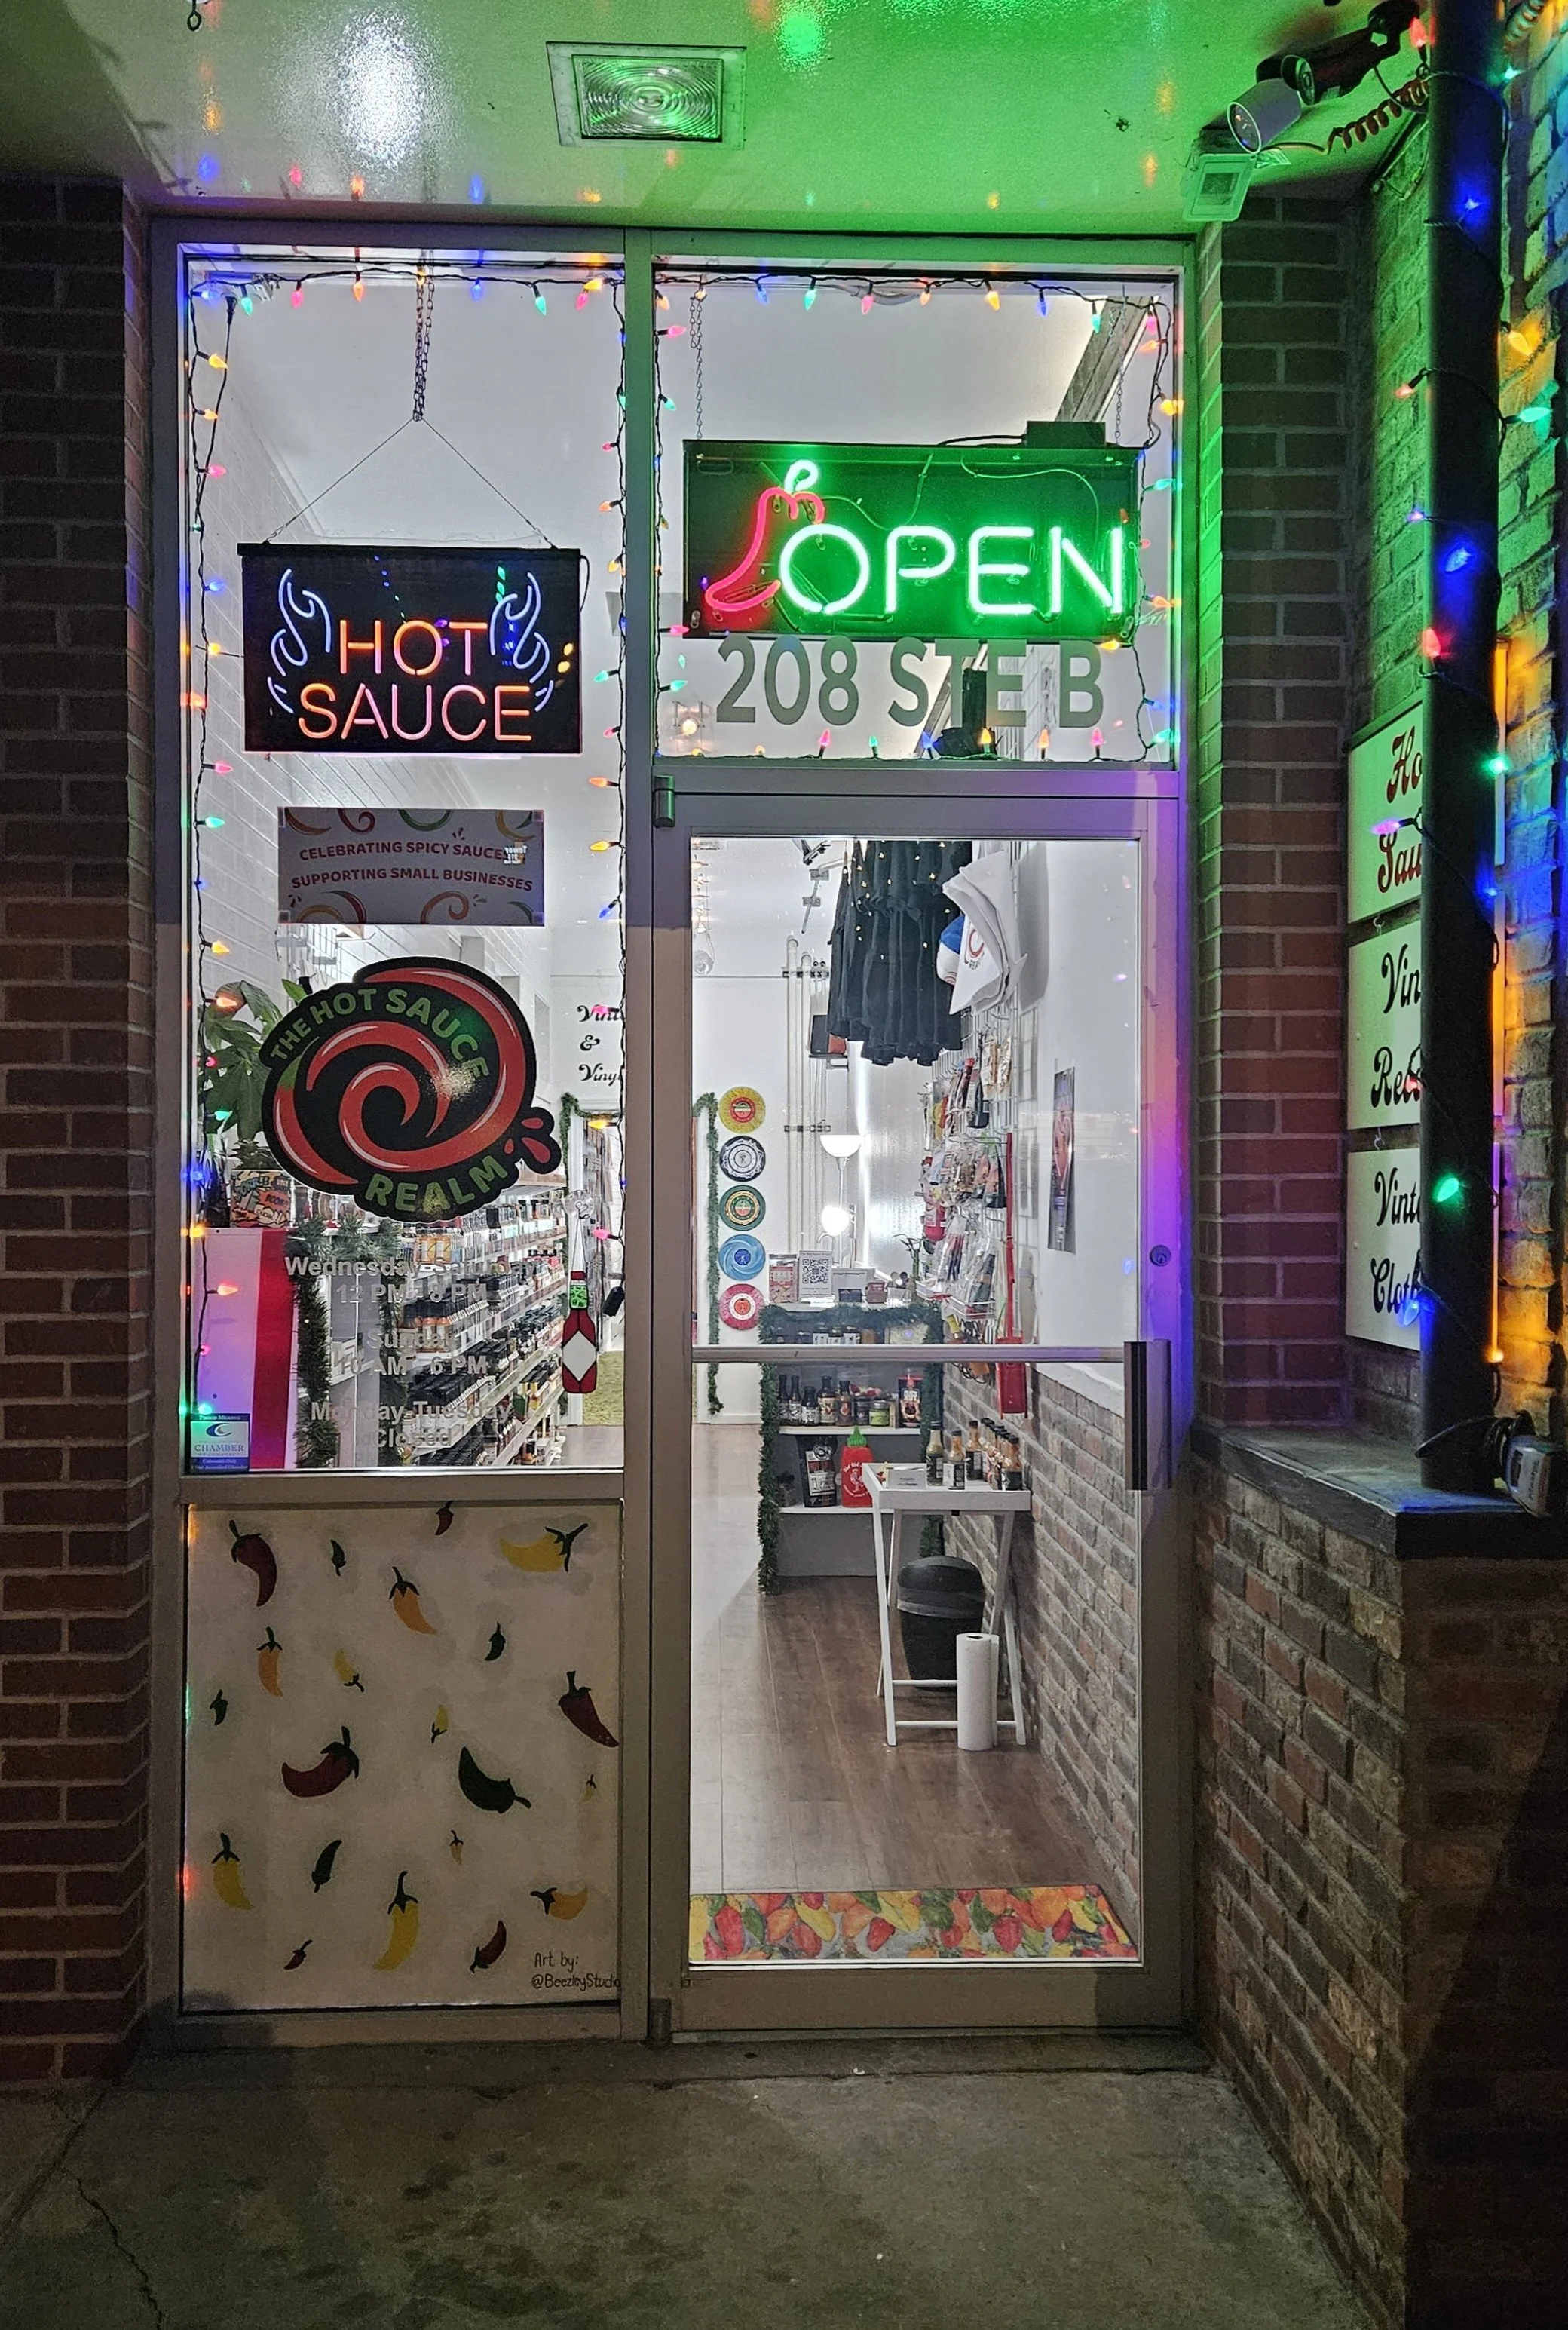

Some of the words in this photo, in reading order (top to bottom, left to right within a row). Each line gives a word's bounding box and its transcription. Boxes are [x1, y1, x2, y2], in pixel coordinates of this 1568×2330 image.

[779, 523, 1122, 615] OPEN
[339, 619, 488, 676] HOT
[716, 635, 859, 726] 208
[887, 636, 1027, 728] STE
[1059, 639, 1104, 729] B
[298, 682, 532, 741] SAUCE
[299, 842, 403, 861] CELEBRATING
[406, 842, 450, 854] SPICY
[452, 844, 511, 861] SAUCE
[291, 869, 387, 889] SUPPORTING
[390, 868, 440, 880] SMALL
[443, 869, 533, 892] BUSINESSES
[270, 1018, 312, 1061] THE
[309, 989, 377, 1026] HOT
[385, 988, 489, 1079] SAUCE
[580, 1035, 601, 1051] &
[364, 1155, 508, 1213] REALM
[371, 1283, 406, 1303] PM
[430, 1283, 443, 1303] 8
[451, 1283, 487, 1304] PM
[369, 1356, 407, 1376] AM
[451, 1355, 488, 1376] PM
[371, 1427, 452, 1448] Closed
[534, 1951, 555, 1968] Art
[560, 1951, 579, 1973] by:
